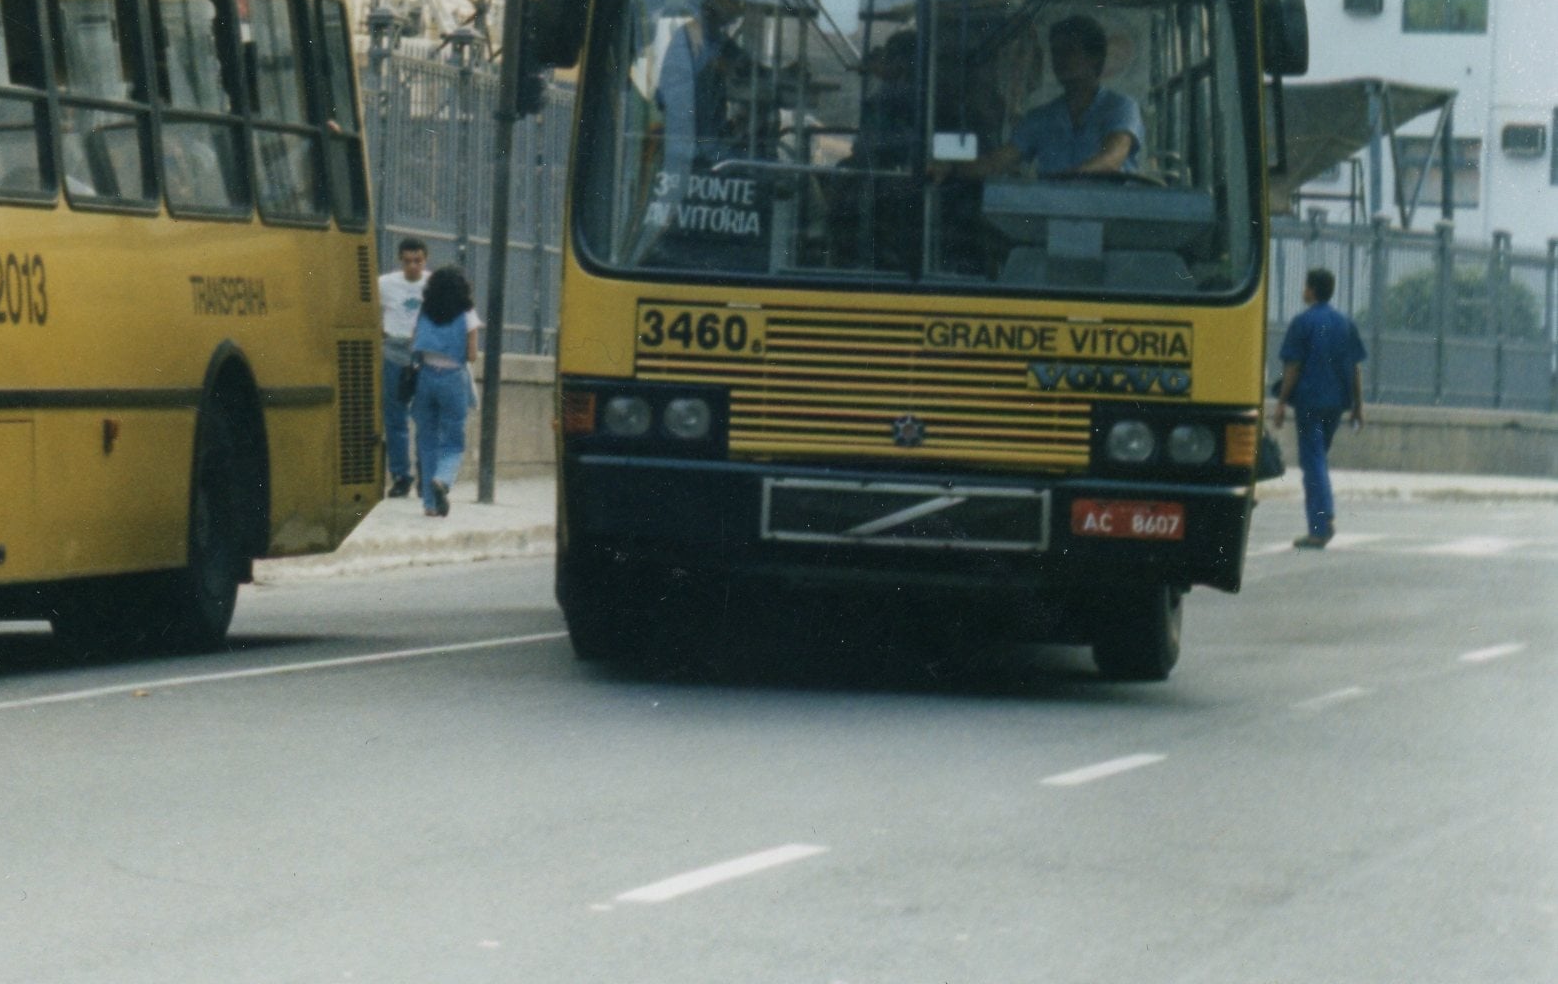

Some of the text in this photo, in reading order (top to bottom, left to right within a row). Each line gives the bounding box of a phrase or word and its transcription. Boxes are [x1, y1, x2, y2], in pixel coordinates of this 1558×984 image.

[687, 175, 757, 205] PONTE
[644, 309, 748, 351] 3460
[926, 321, 1058, 353] GRANDE
[1083, 512, 1114, 532] AC
